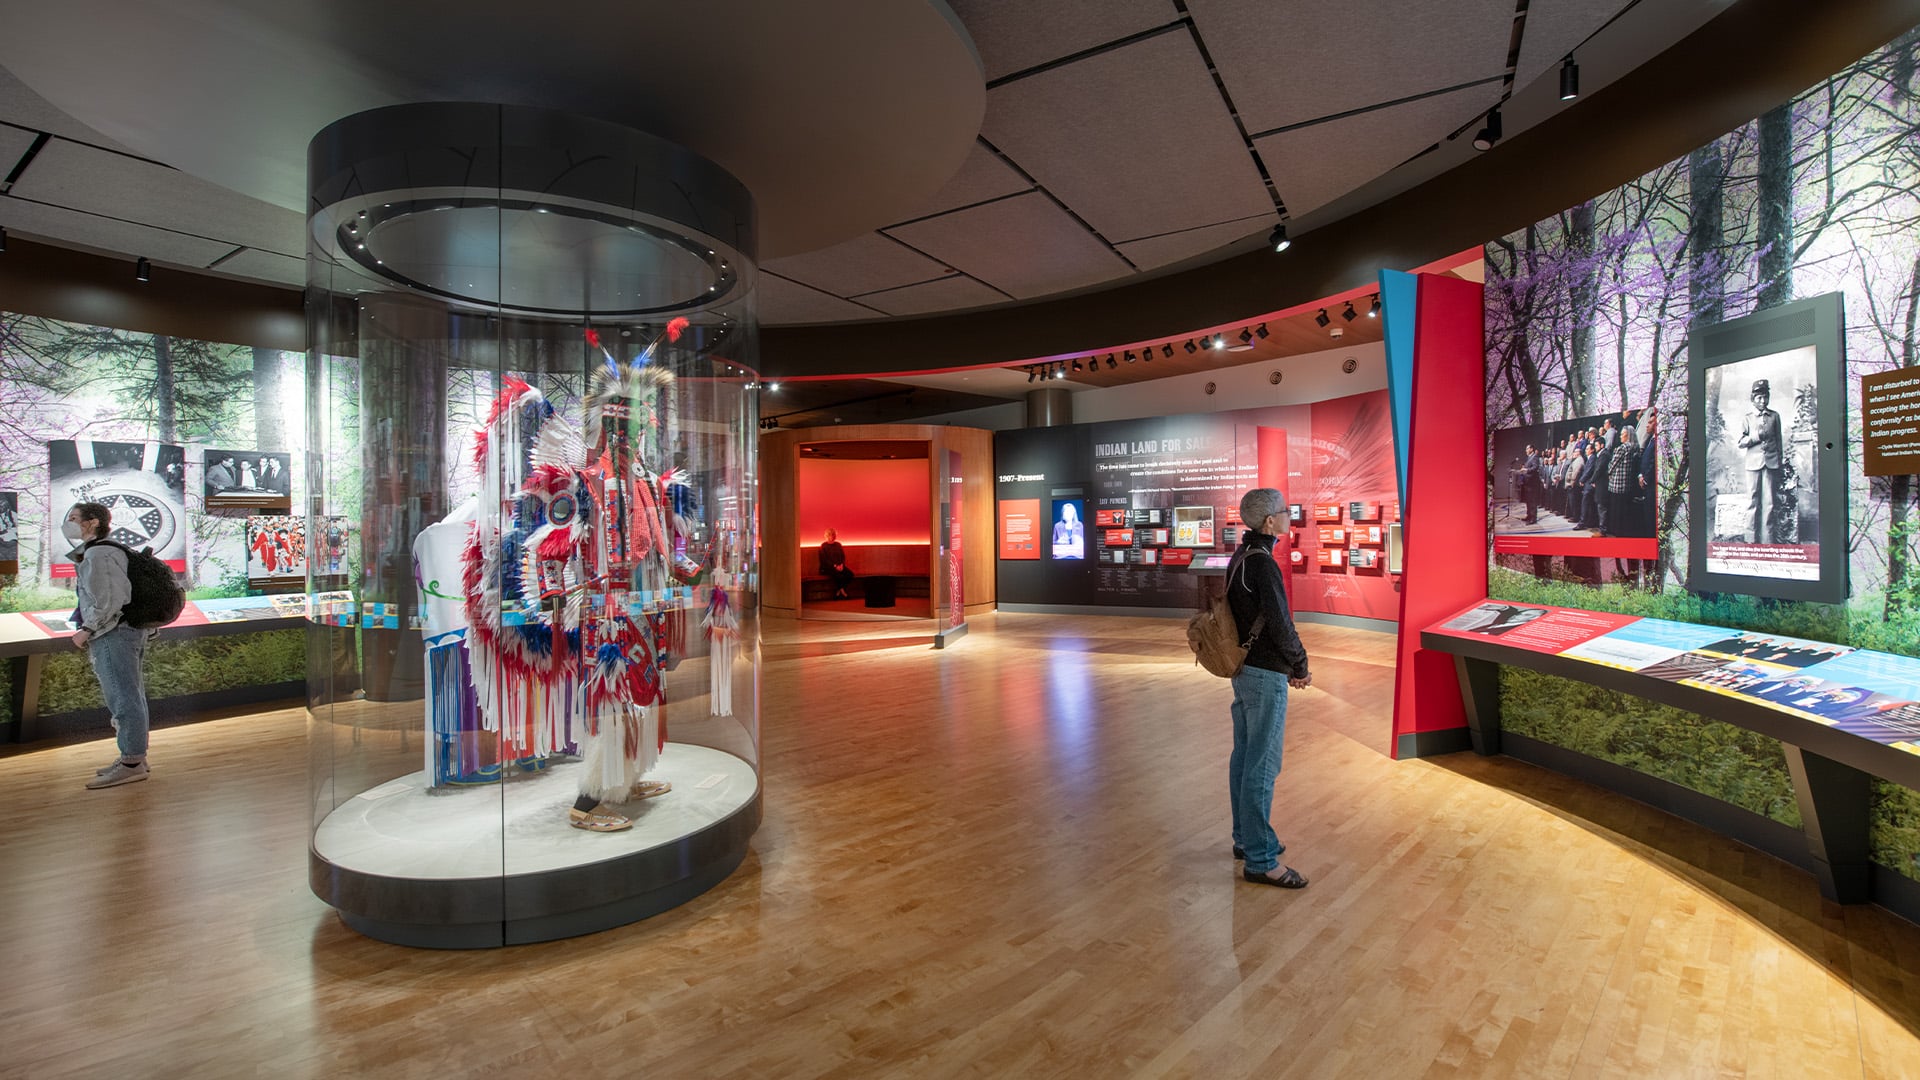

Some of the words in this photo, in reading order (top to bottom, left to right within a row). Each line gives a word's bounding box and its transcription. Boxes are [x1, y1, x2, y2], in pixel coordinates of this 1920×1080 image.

[1883, 379, 1912, 390] disturbed
[1900, 390, 1920, 399] Ameri
[1869, 406, 1898, 415] accepting
[1899, 403, 1909, 411] the
[1890, 427, 1918, 437] progress.
[1095, 443, 1128, 457] INDIAN
[1131, 440, 1158, 454] LAND
[1161, 438, 1181, 452] FOR
